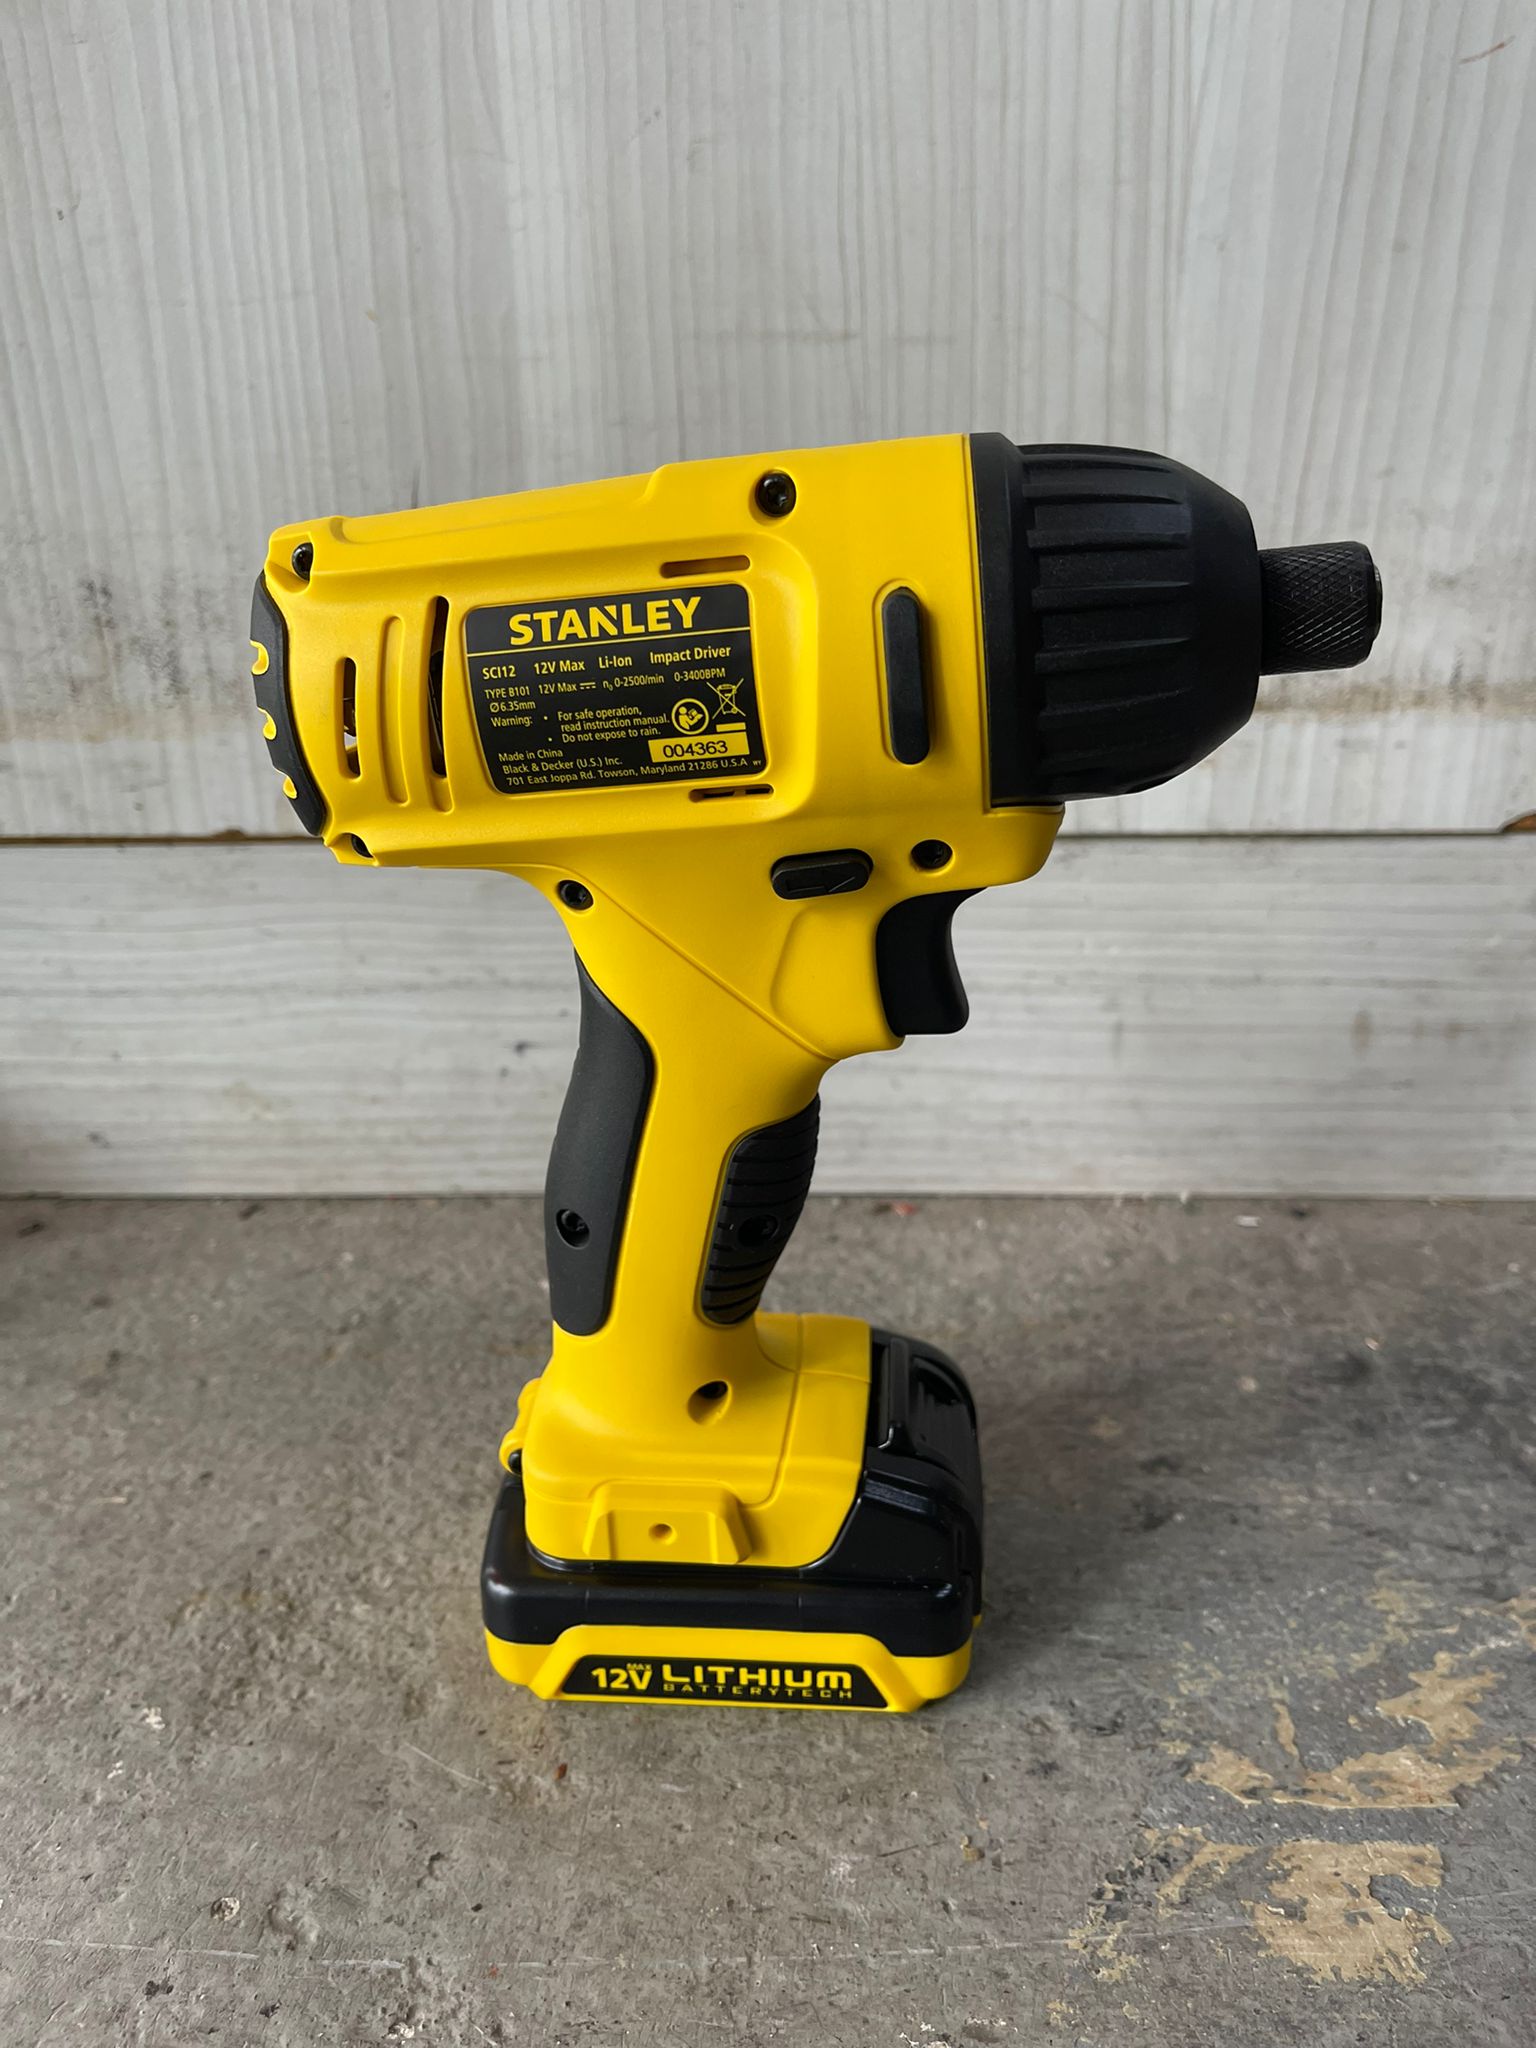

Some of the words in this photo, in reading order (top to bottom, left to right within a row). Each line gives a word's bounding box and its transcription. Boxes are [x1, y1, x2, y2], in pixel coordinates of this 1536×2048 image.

[509, 596, 701, 646] STANLEY
[482, 665, 516, 680] SCI12
[534, 661, 556, 675] 12V
[559, 660, 585, 673] Max
[599, 656, 633, 669] Li-Ion
[650, 649, 691, 665] Impact
[694, 646, 731, 659] Driver
[485, 688, 507, 699] TYPE
[508, 686, 530, 697] B101
[539, 683, 555, 695] 12V
[558, 682, 577, 693] Max
[614, 674, 664, 687] 0-2500/min
[674, 667, 726, 682] 0-3400BPM
[490, 715, 533, 727] Warning:
[557, 711, 573, 721] For
[575, 708, 594, 720] safe
[595, 706, 642, 719] operation,
[560, 722, 582, 733] read
[583, 718, 632, 731] instruction
[633, 713, 670, 725] manual.
[562, 733, 576, 743] Do
[577, 732, 593, 742] not
[595, 730, 626, 742] expose
[628, 728, 639, 738] to
[640, 725, 661, 737] rain.
[498, 751, 524, 762] Made
[526, 751, 536, 760] in
[537, 748, 563, 759] China
[663, 740, 728, 758] 004363
[502, 764, 530, 775] Black
[531, 762, 540, 772] &
[541, 760, 574, 771] Decker
[577, 757, 603, 769] (U.S.)
[604, 756, 623, 766] Inc.
[507, 776, 524, 786] 701
[527, 774, 548, 785] East
[550, 772, 578, 784] Joppa
[580, 770, 596, 780] Rd.
[598, 767, 639, 778] Towson,
[640, 762, 686, 776] Maryland
[688, 760, 719, 771] 21286
[626, 1663, 652, 1671] MAX
[591, 1667, 653, 1691] 12V
